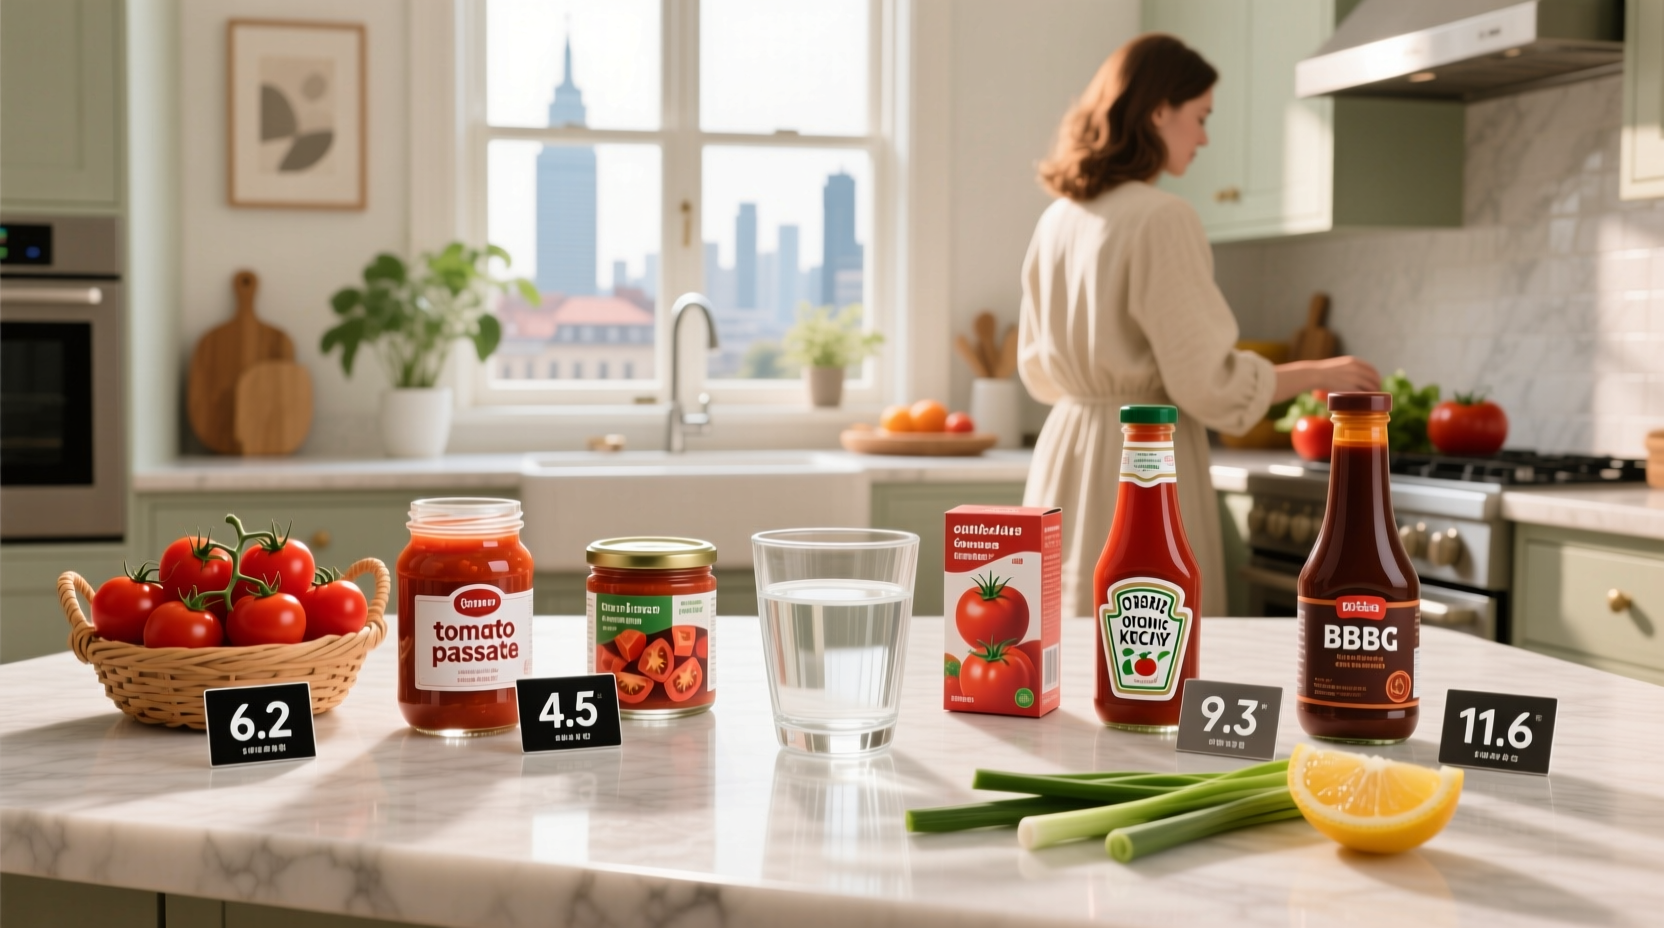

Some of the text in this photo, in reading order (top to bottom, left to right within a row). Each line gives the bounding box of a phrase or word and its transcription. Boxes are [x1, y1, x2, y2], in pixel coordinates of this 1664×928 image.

[433, 619, 515, 641] tomato
[432, 640, 519, 667] passate
[230, 700, 292, 741] 6.2
[538, 690, 598, 728] 4.5
[1201, 695, 1259, 736] 9.3
[1459, 707, 1533, 749] 11.6
